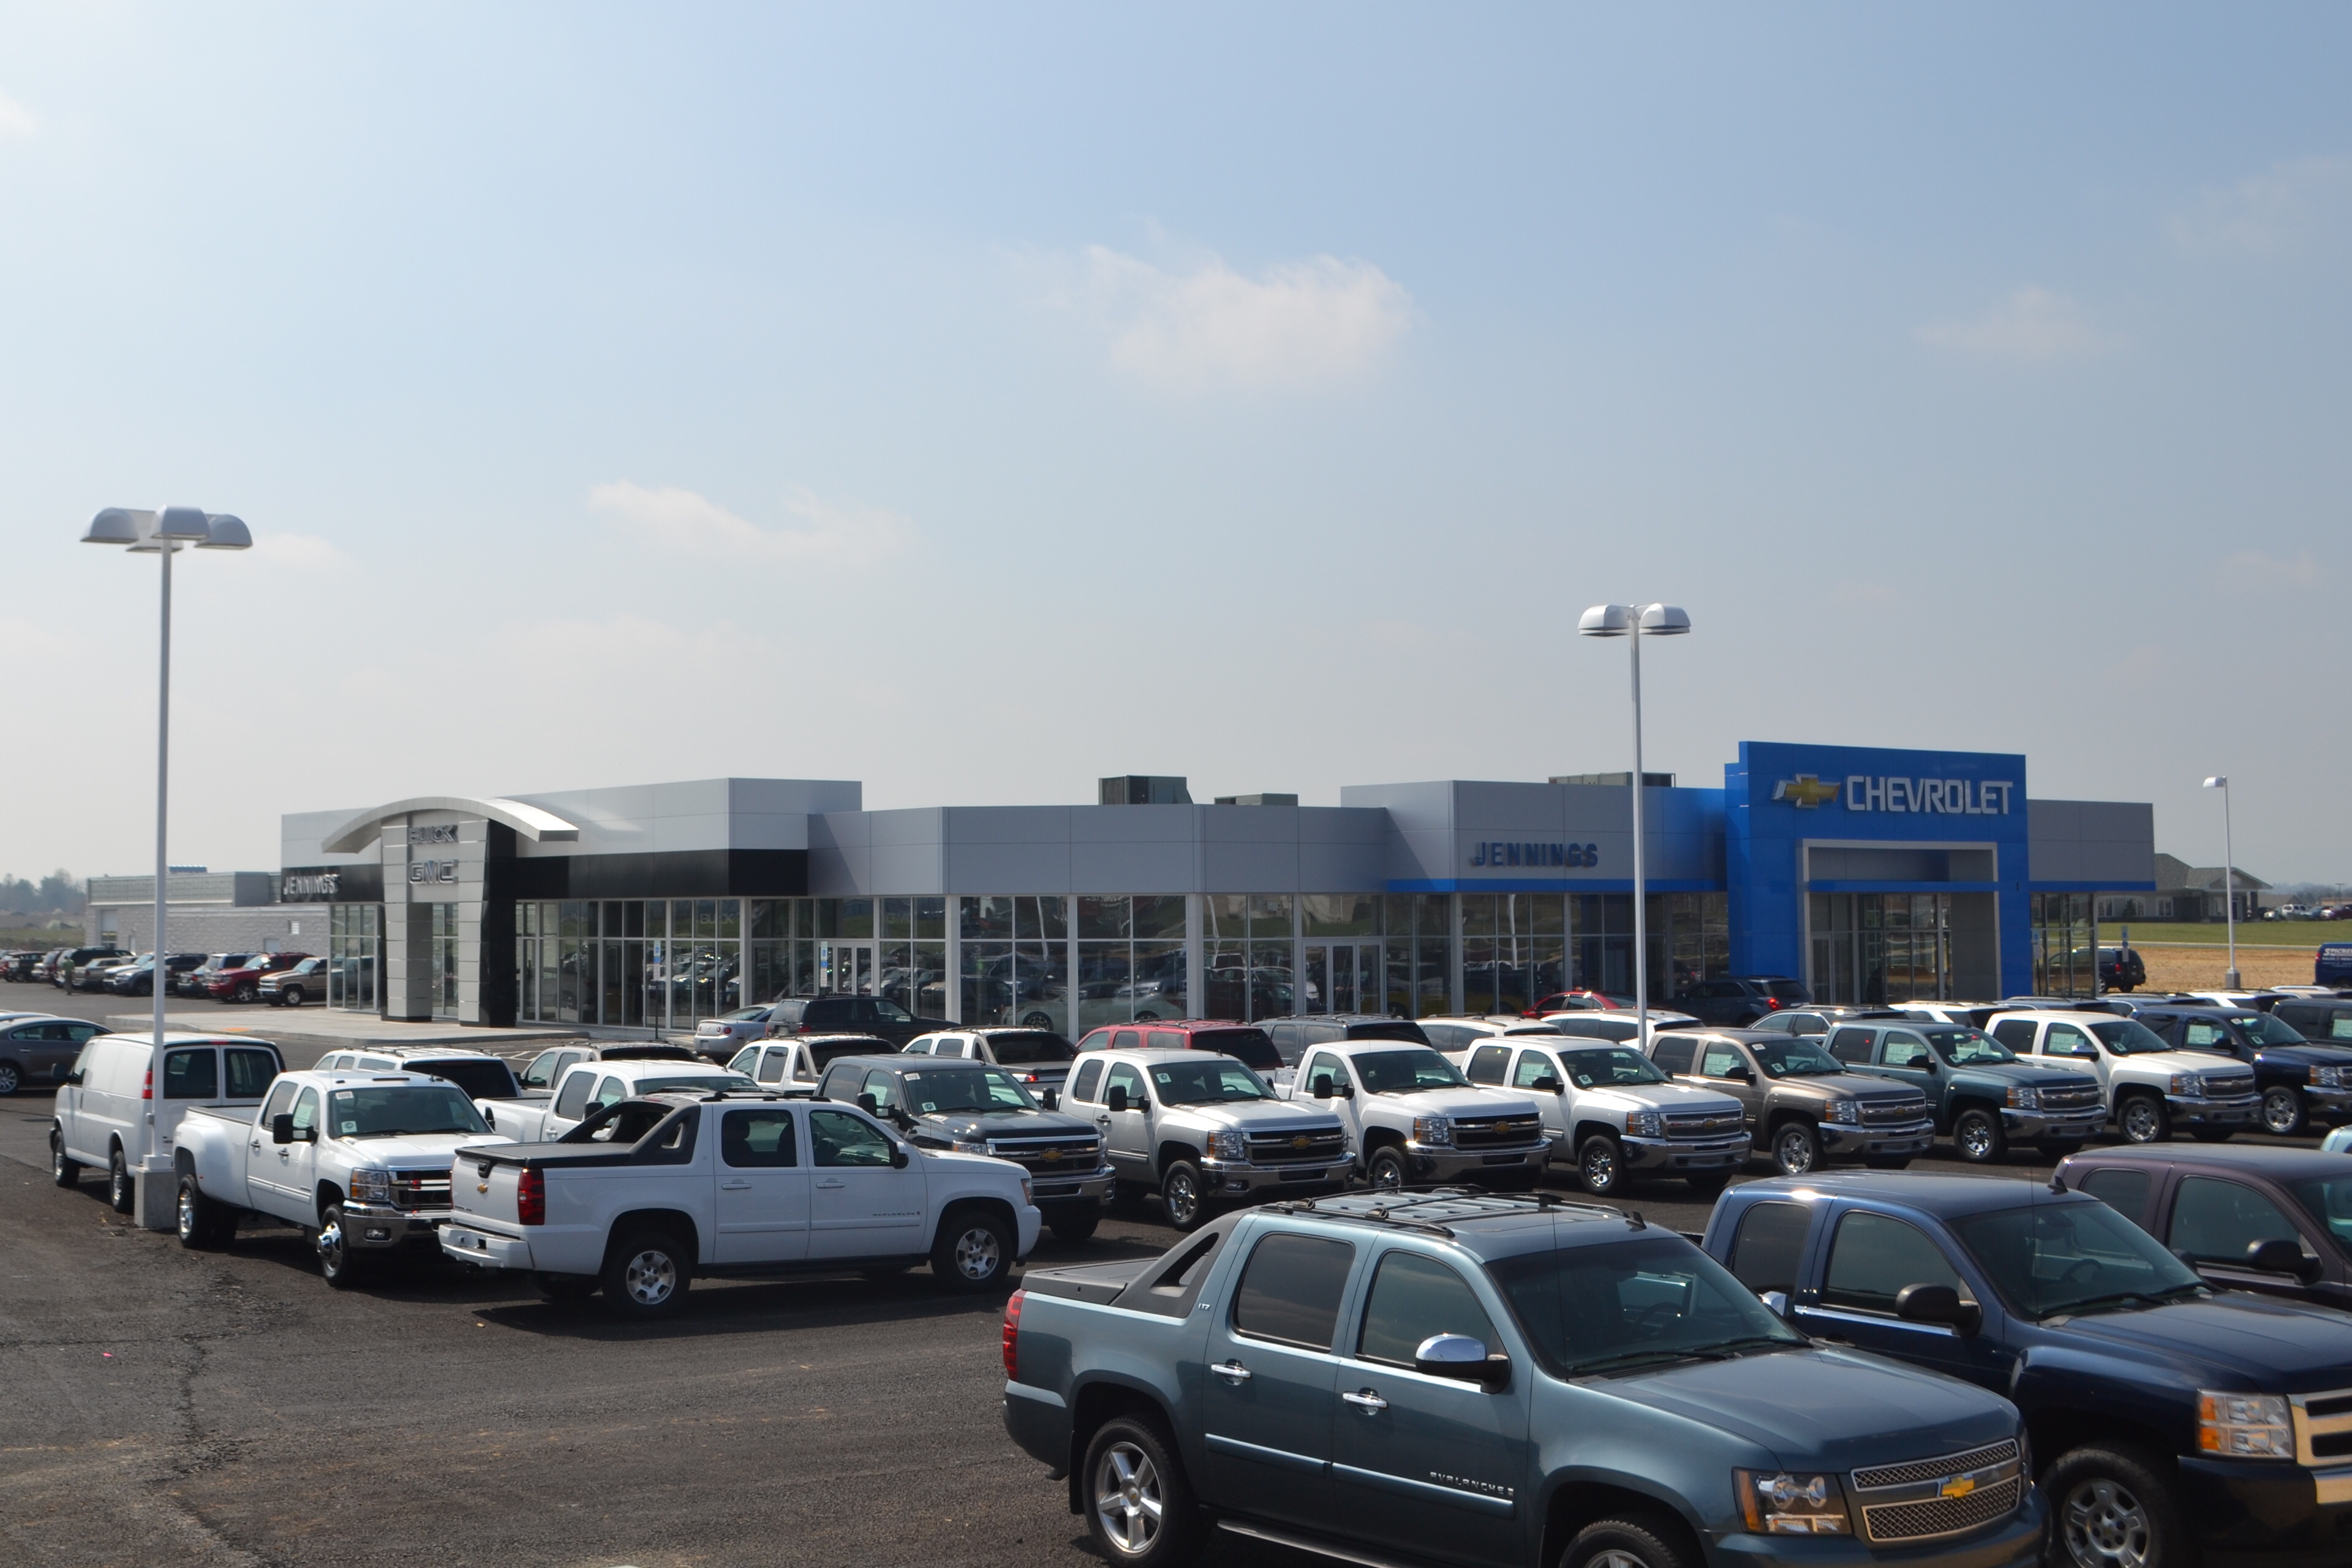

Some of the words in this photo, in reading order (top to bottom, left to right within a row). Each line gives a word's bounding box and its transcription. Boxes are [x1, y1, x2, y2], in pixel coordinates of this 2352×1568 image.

[1846, 775, 2013, 815] CHEVROLET
[409, 825, 458, 843] BUICK
[1475, 842, 1599, 867] JENNINGS
[409, 859, 458, 884] GMC
[284, 874, 340, 895] JENNINGS
[701, 913, 734, 924] BUCK
[1430, 1472, 1504, 1495] AVALANCHE
